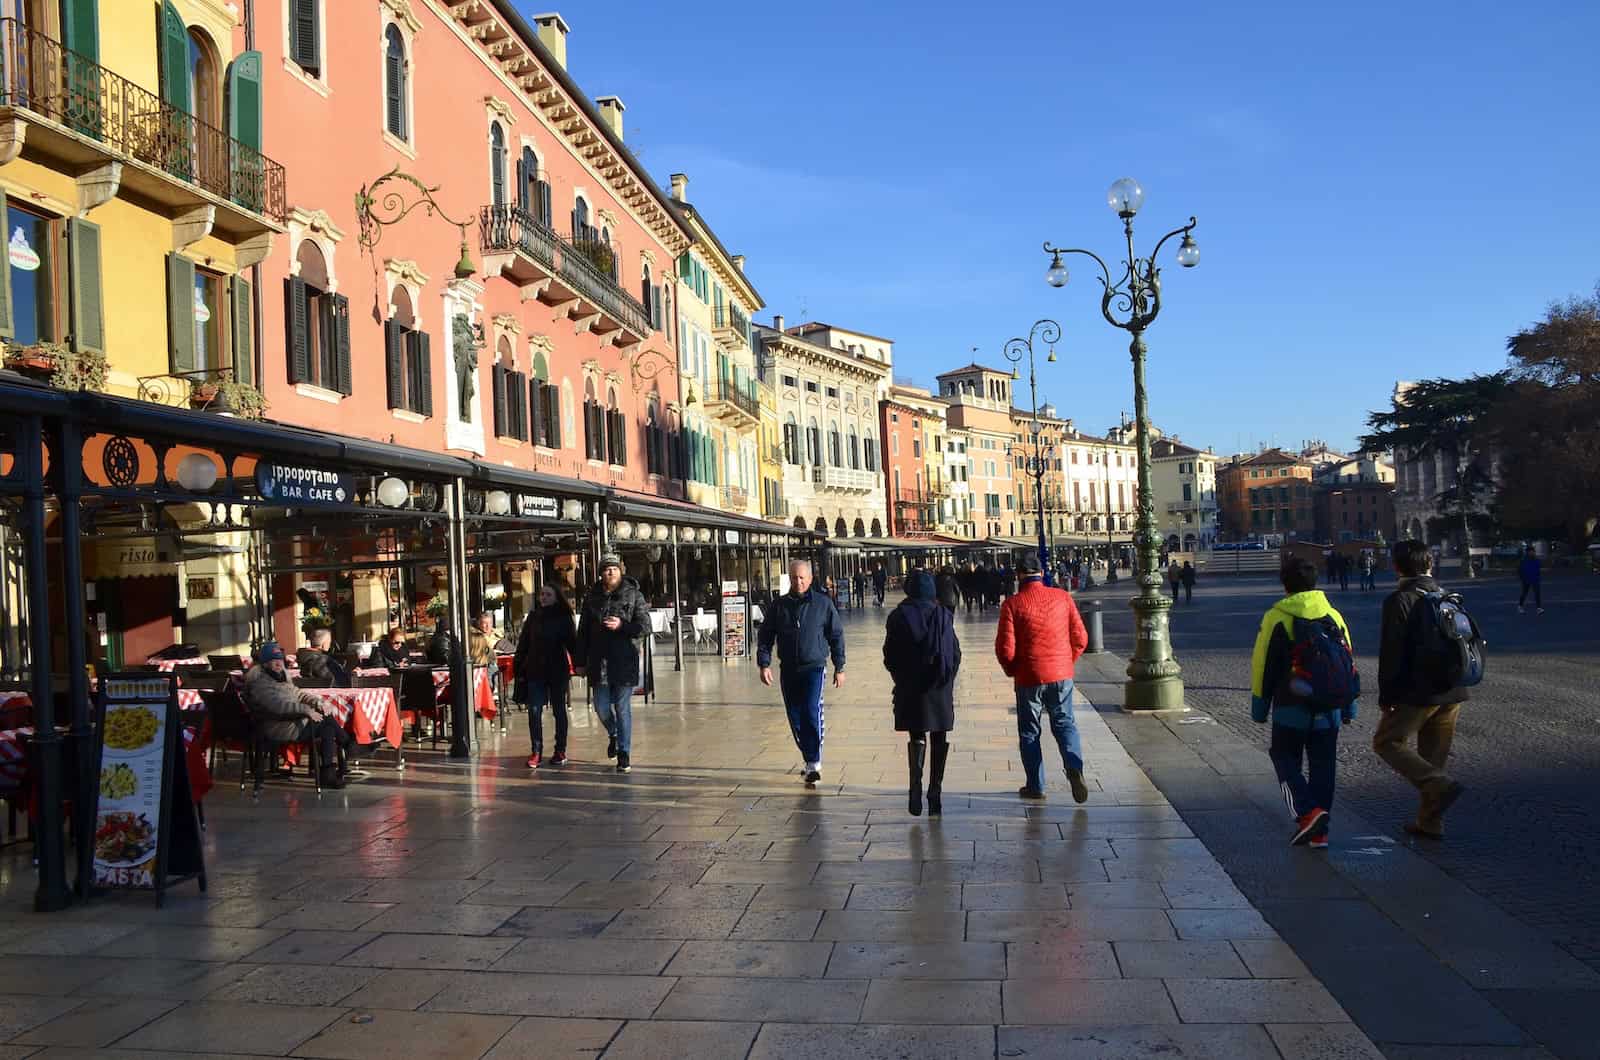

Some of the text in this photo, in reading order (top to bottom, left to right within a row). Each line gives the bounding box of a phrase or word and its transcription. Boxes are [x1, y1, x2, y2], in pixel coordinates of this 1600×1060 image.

[282, 486, 333, 501] BAR CAFE
[120, 548, 154, 561] risto
[95, 867, 153, 886] PASTA
